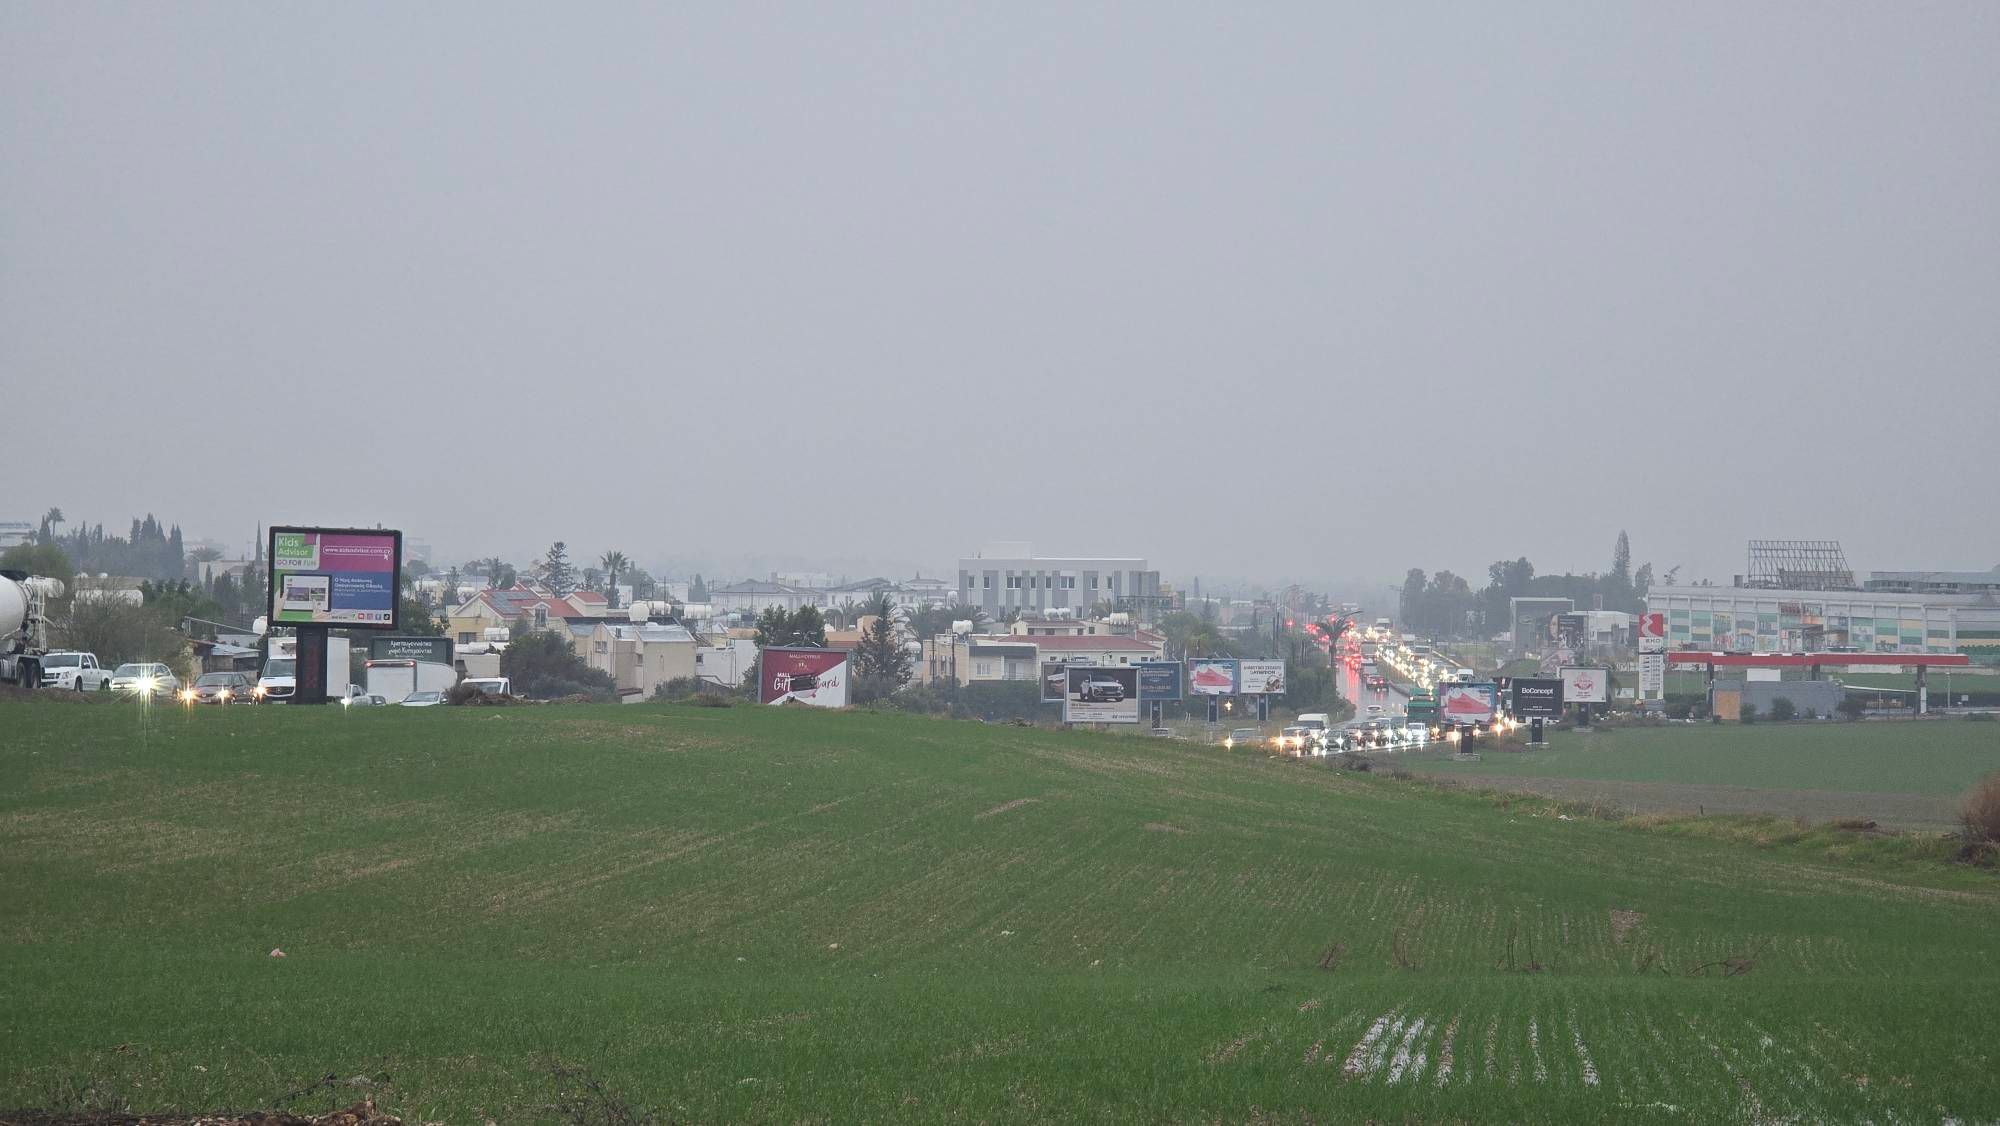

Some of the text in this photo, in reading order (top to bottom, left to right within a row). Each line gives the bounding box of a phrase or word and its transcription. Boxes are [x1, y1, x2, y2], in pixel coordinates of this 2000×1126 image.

[278, 536, 299, 547] Kids
[278, 547, 308, 557] Advisor
[1521, 687, 1553, 696] BoConcept
